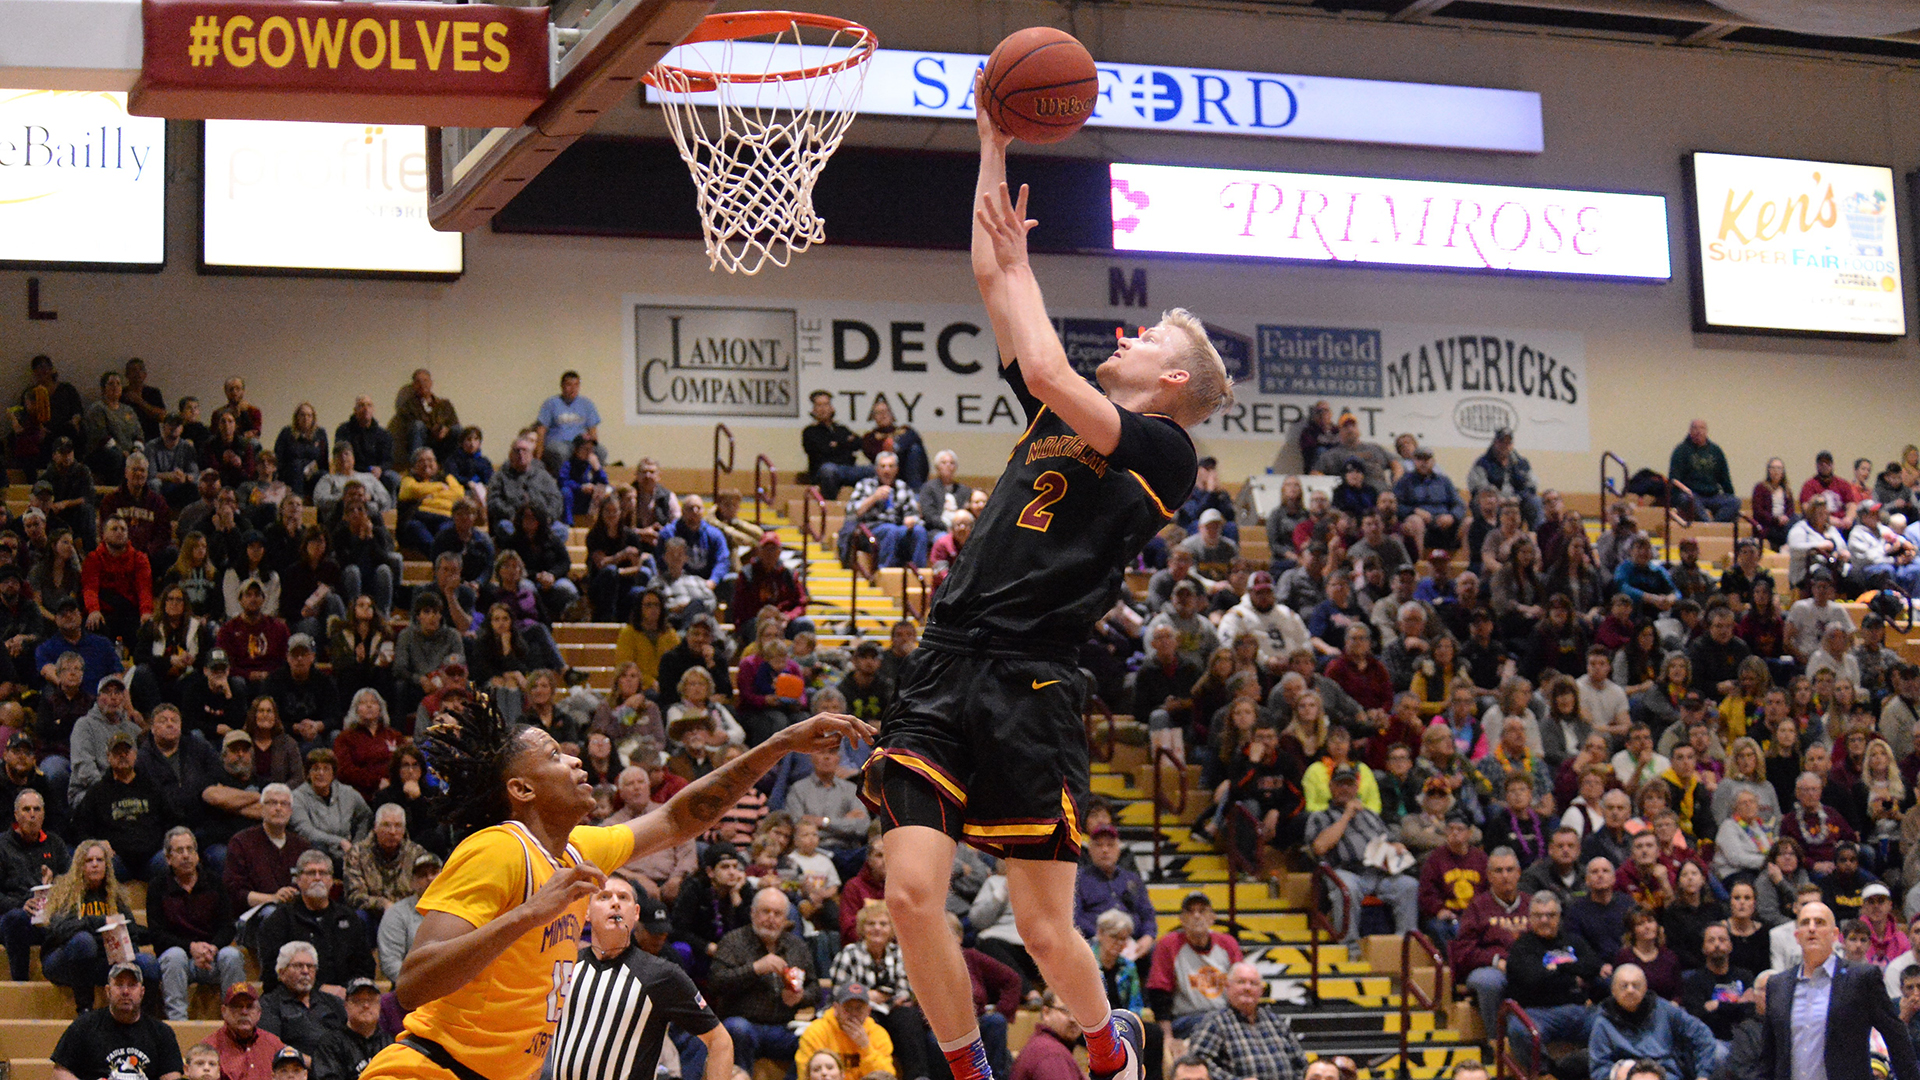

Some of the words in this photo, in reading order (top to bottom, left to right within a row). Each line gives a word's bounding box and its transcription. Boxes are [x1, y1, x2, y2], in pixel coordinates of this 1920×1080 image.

[188, 15, 511, 73] #GOWOLVES
[1219, 180, 1601, 270] PRIMROSE
[1716, 171, 1838, 246] Ken's
[27, 277, 57, 320] L
[1109, 267, 1148, 307] M
[668, 315, 790, 372] LAMONT
[800, 317, 822, 371] THE
[832, 319, 1004, 379] DEC
[1262, 329, 1377, 360] Fairfield
[1386, 334, 1578, 405] MAVERICKS
[641, 357, 791, 406] COMPANIES
[812, 390, 923, 425] TAY
[1016, 470, 1068, 533] 2
